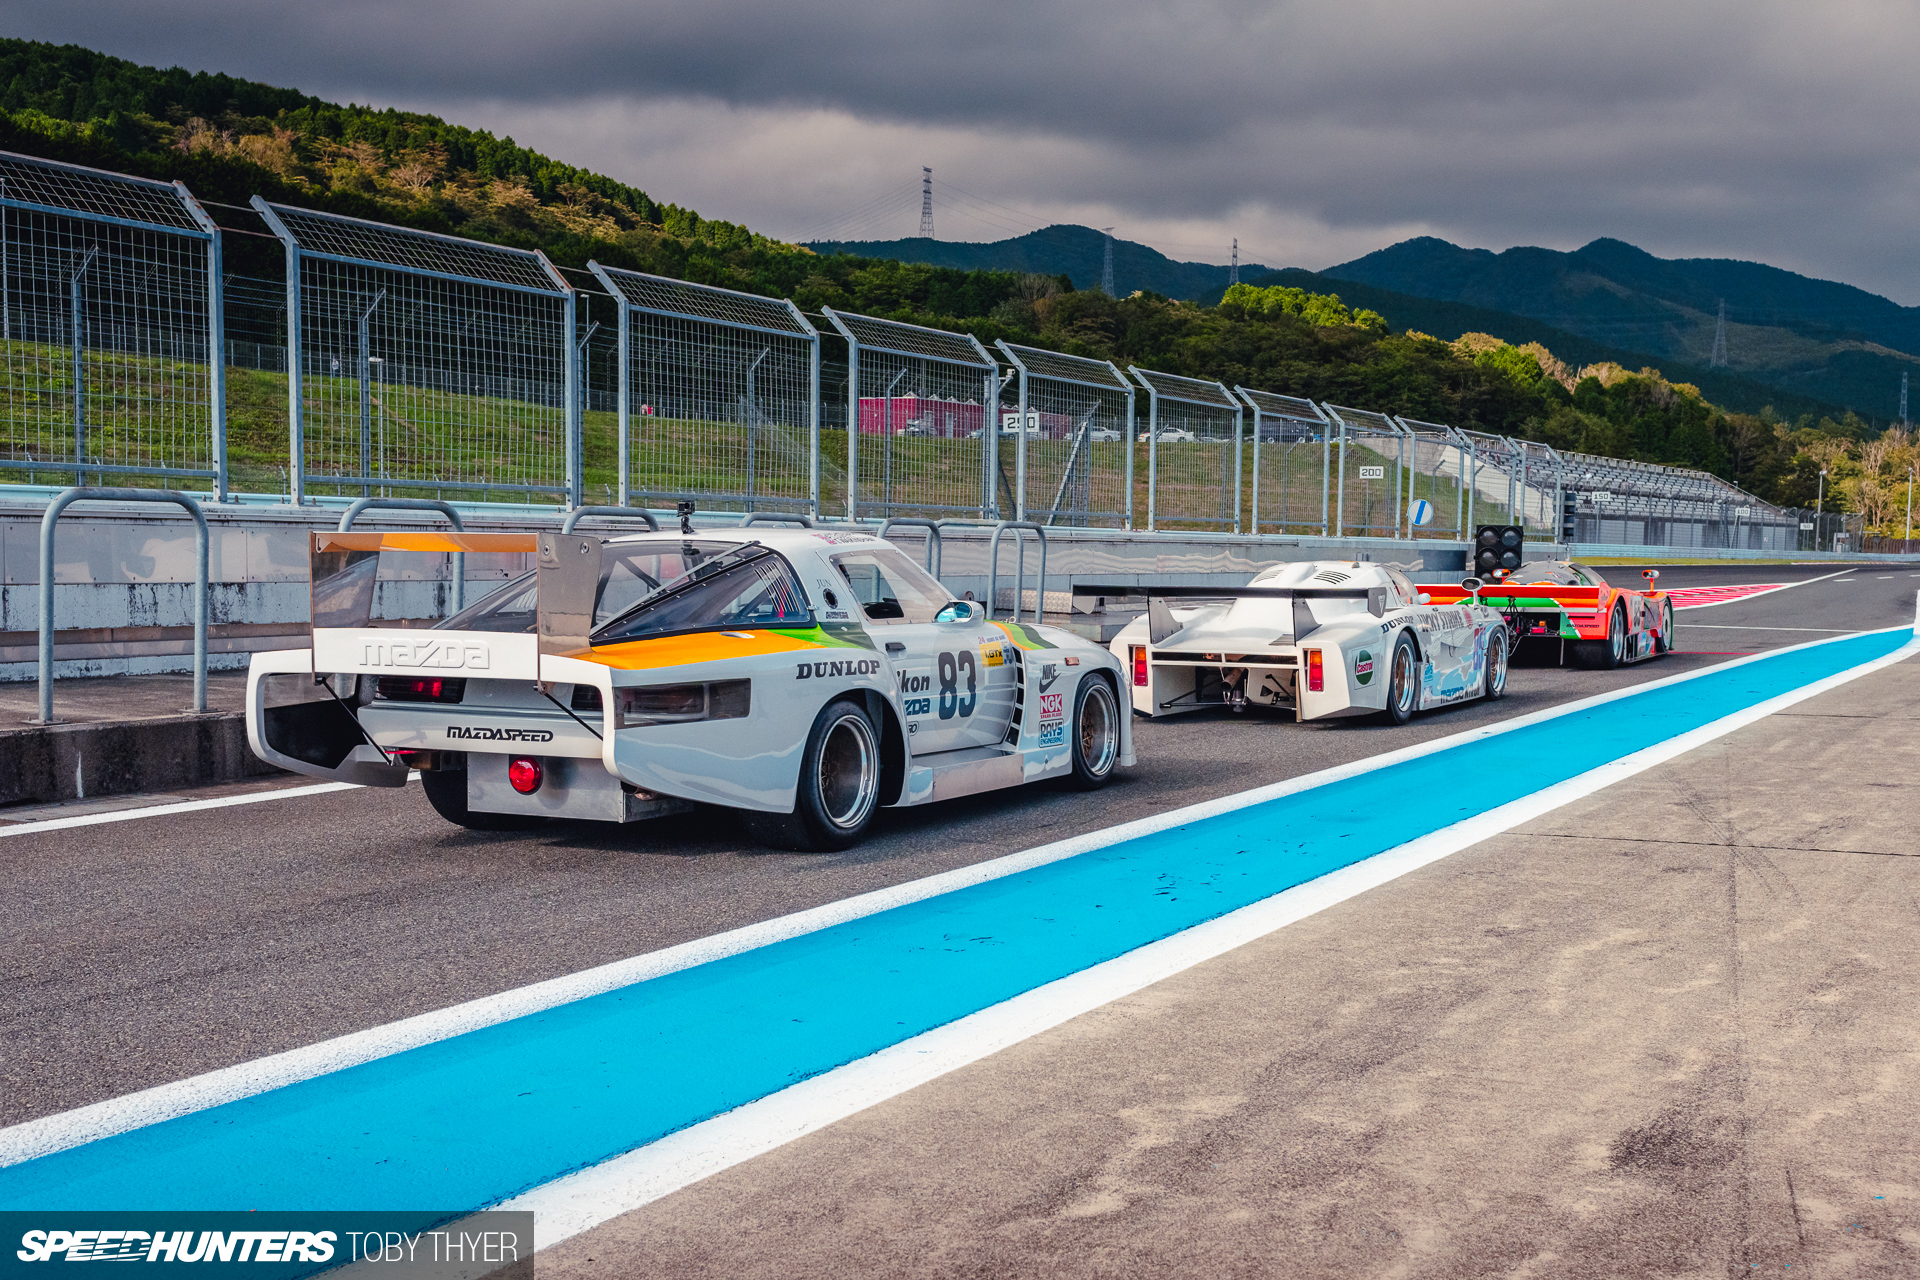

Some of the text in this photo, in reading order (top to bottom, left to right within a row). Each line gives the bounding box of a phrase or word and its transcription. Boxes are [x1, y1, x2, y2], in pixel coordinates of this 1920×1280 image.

[1361, 468, 1382, 477] 200
[1380, 615, 1414, 635] DUNLOP
[978, 636, 986, 645] 24
[795, 659, 881, 680] DUNLOP
[1042, 663, 1057, 681] NIKE
[1356, 660, 1374, 674] Castrol
[937, 650, 977, 720] 83
[1040, 694, 1063, 714] NGK
[446, 725, 554, 743] MAZDASPEED
[1040, 721, 1063, 739] RAYS
